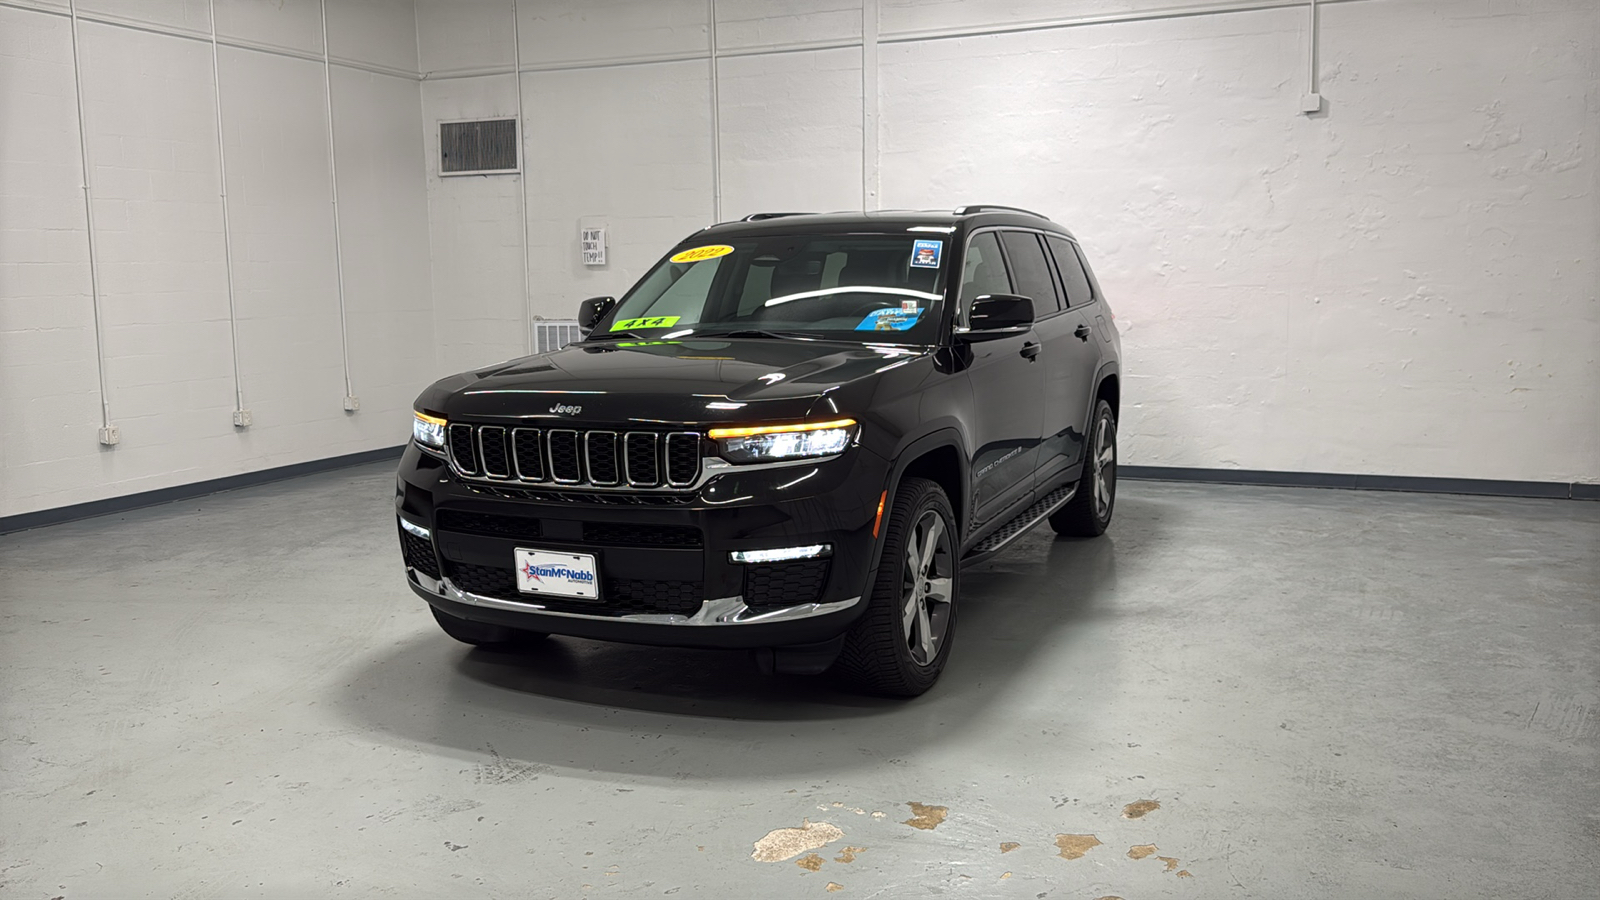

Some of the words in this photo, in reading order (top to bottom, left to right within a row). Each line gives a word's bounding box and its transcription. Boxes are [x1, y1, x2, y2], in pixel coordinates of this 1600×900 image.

[590, 230, 601, 241] NOT
[677, 247, 725, 261] 2022
[549, 402, 582, 416] Jeep
